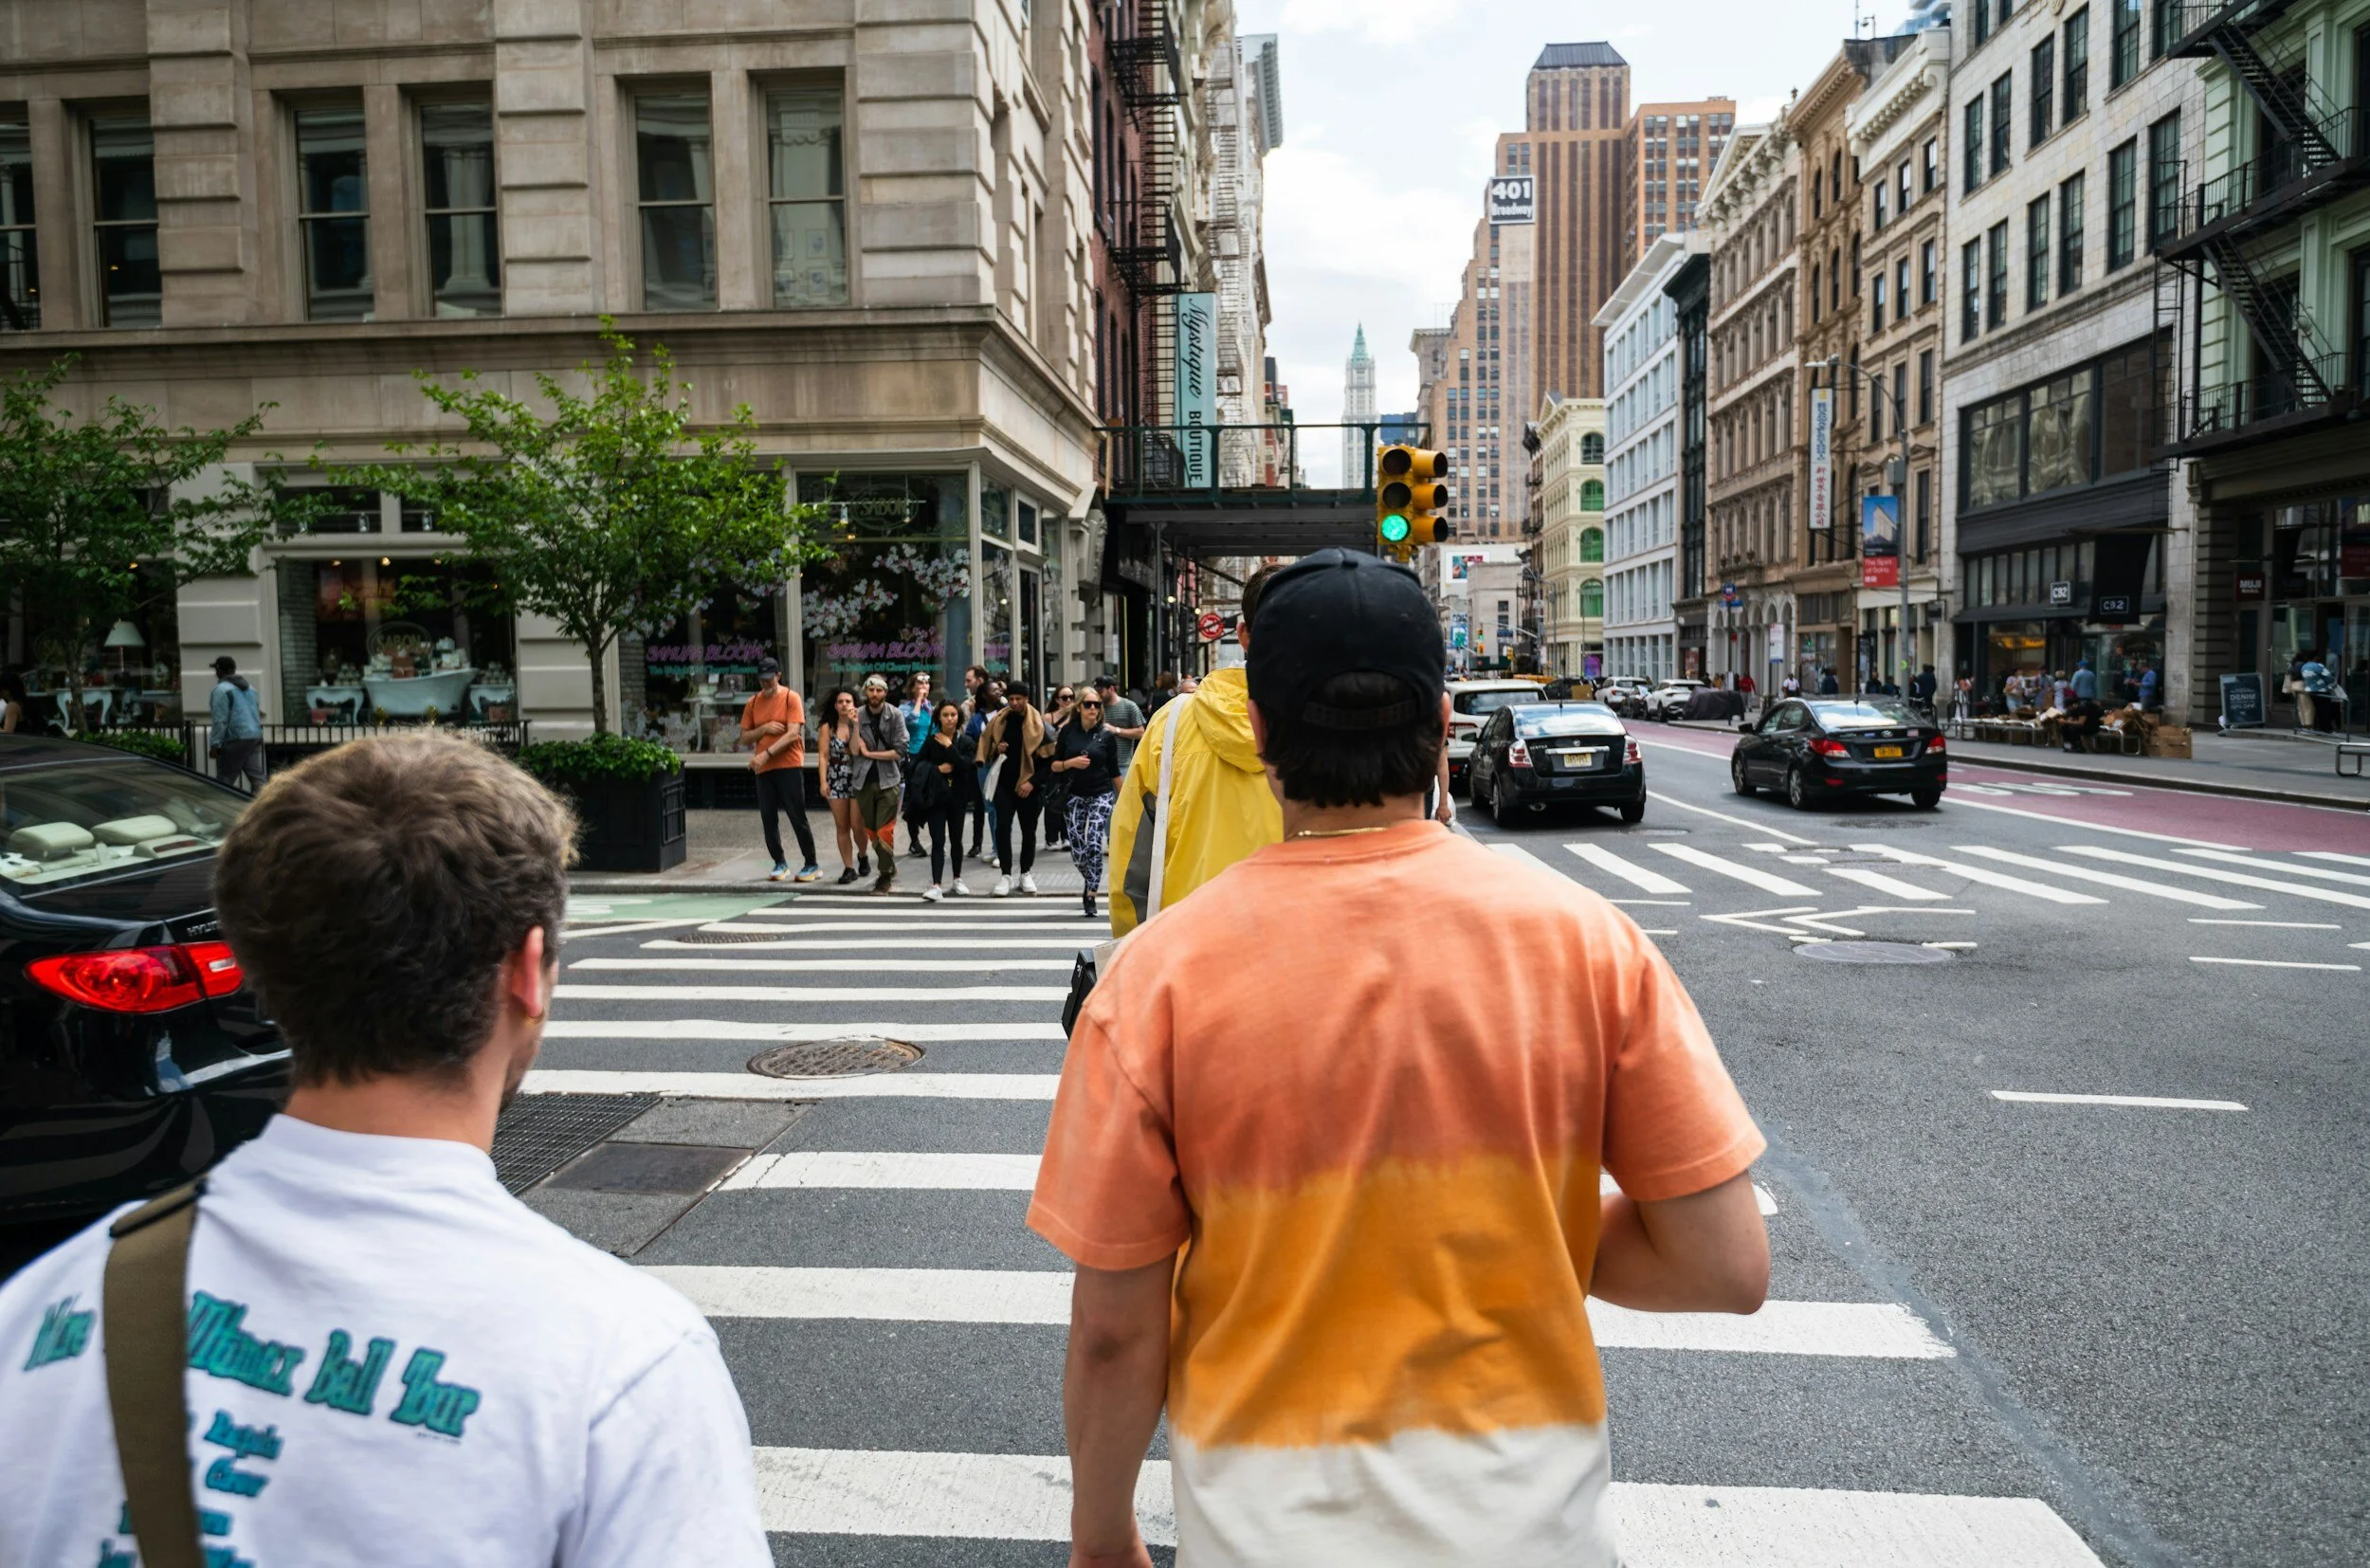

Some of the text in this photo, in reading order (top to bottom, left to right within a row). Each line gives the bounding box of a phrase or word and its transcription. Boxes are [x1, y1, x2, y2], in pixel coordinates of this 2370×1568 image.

[1492, 181, 1531, 199] 401
[1492, 202, 1532, 218] Broadway
[1182, 299, 1209, 482] Mystique BOUTIQUE
[2239, 579, 2262, 588] MUJI
[2052, 587, 2068, 598] CB2
[2103, 600, 2124, 611] CB2
[886, 641, 945, 658] BLOOM
[303, 1328, 396, 1416] Ball
[390, 1346, 482, 1438] Tour
